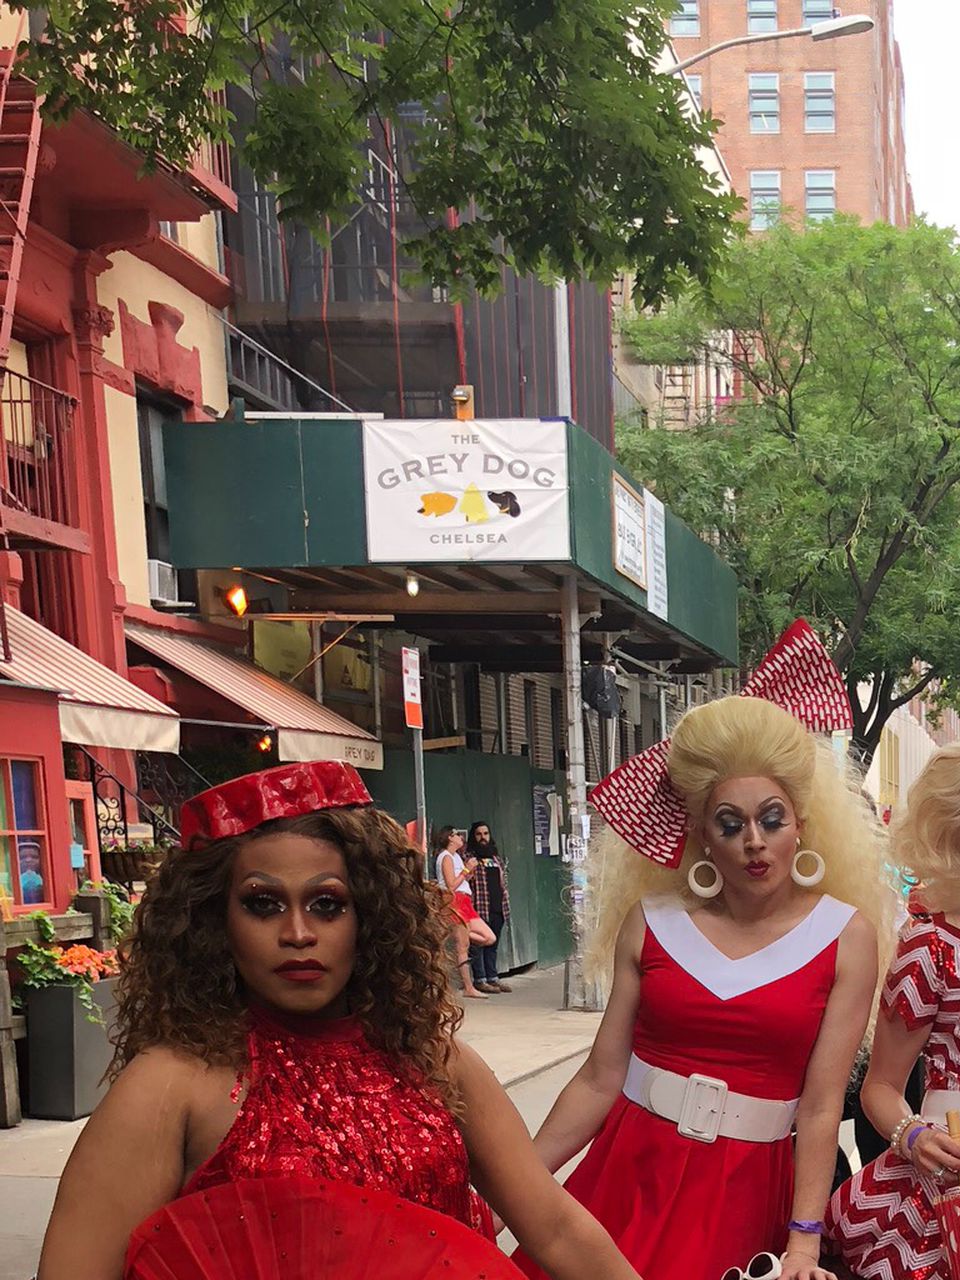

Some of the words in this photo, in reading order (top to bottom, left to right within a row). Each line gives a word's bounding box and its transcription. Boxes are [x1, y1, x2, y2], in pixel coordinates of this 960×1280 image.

[451, 434, 480, 445] THE
[377, 453, 469, 489] GREY
[483, 454, 556, 488] DOG
[429, 533, 508, 544] CHELSEA
